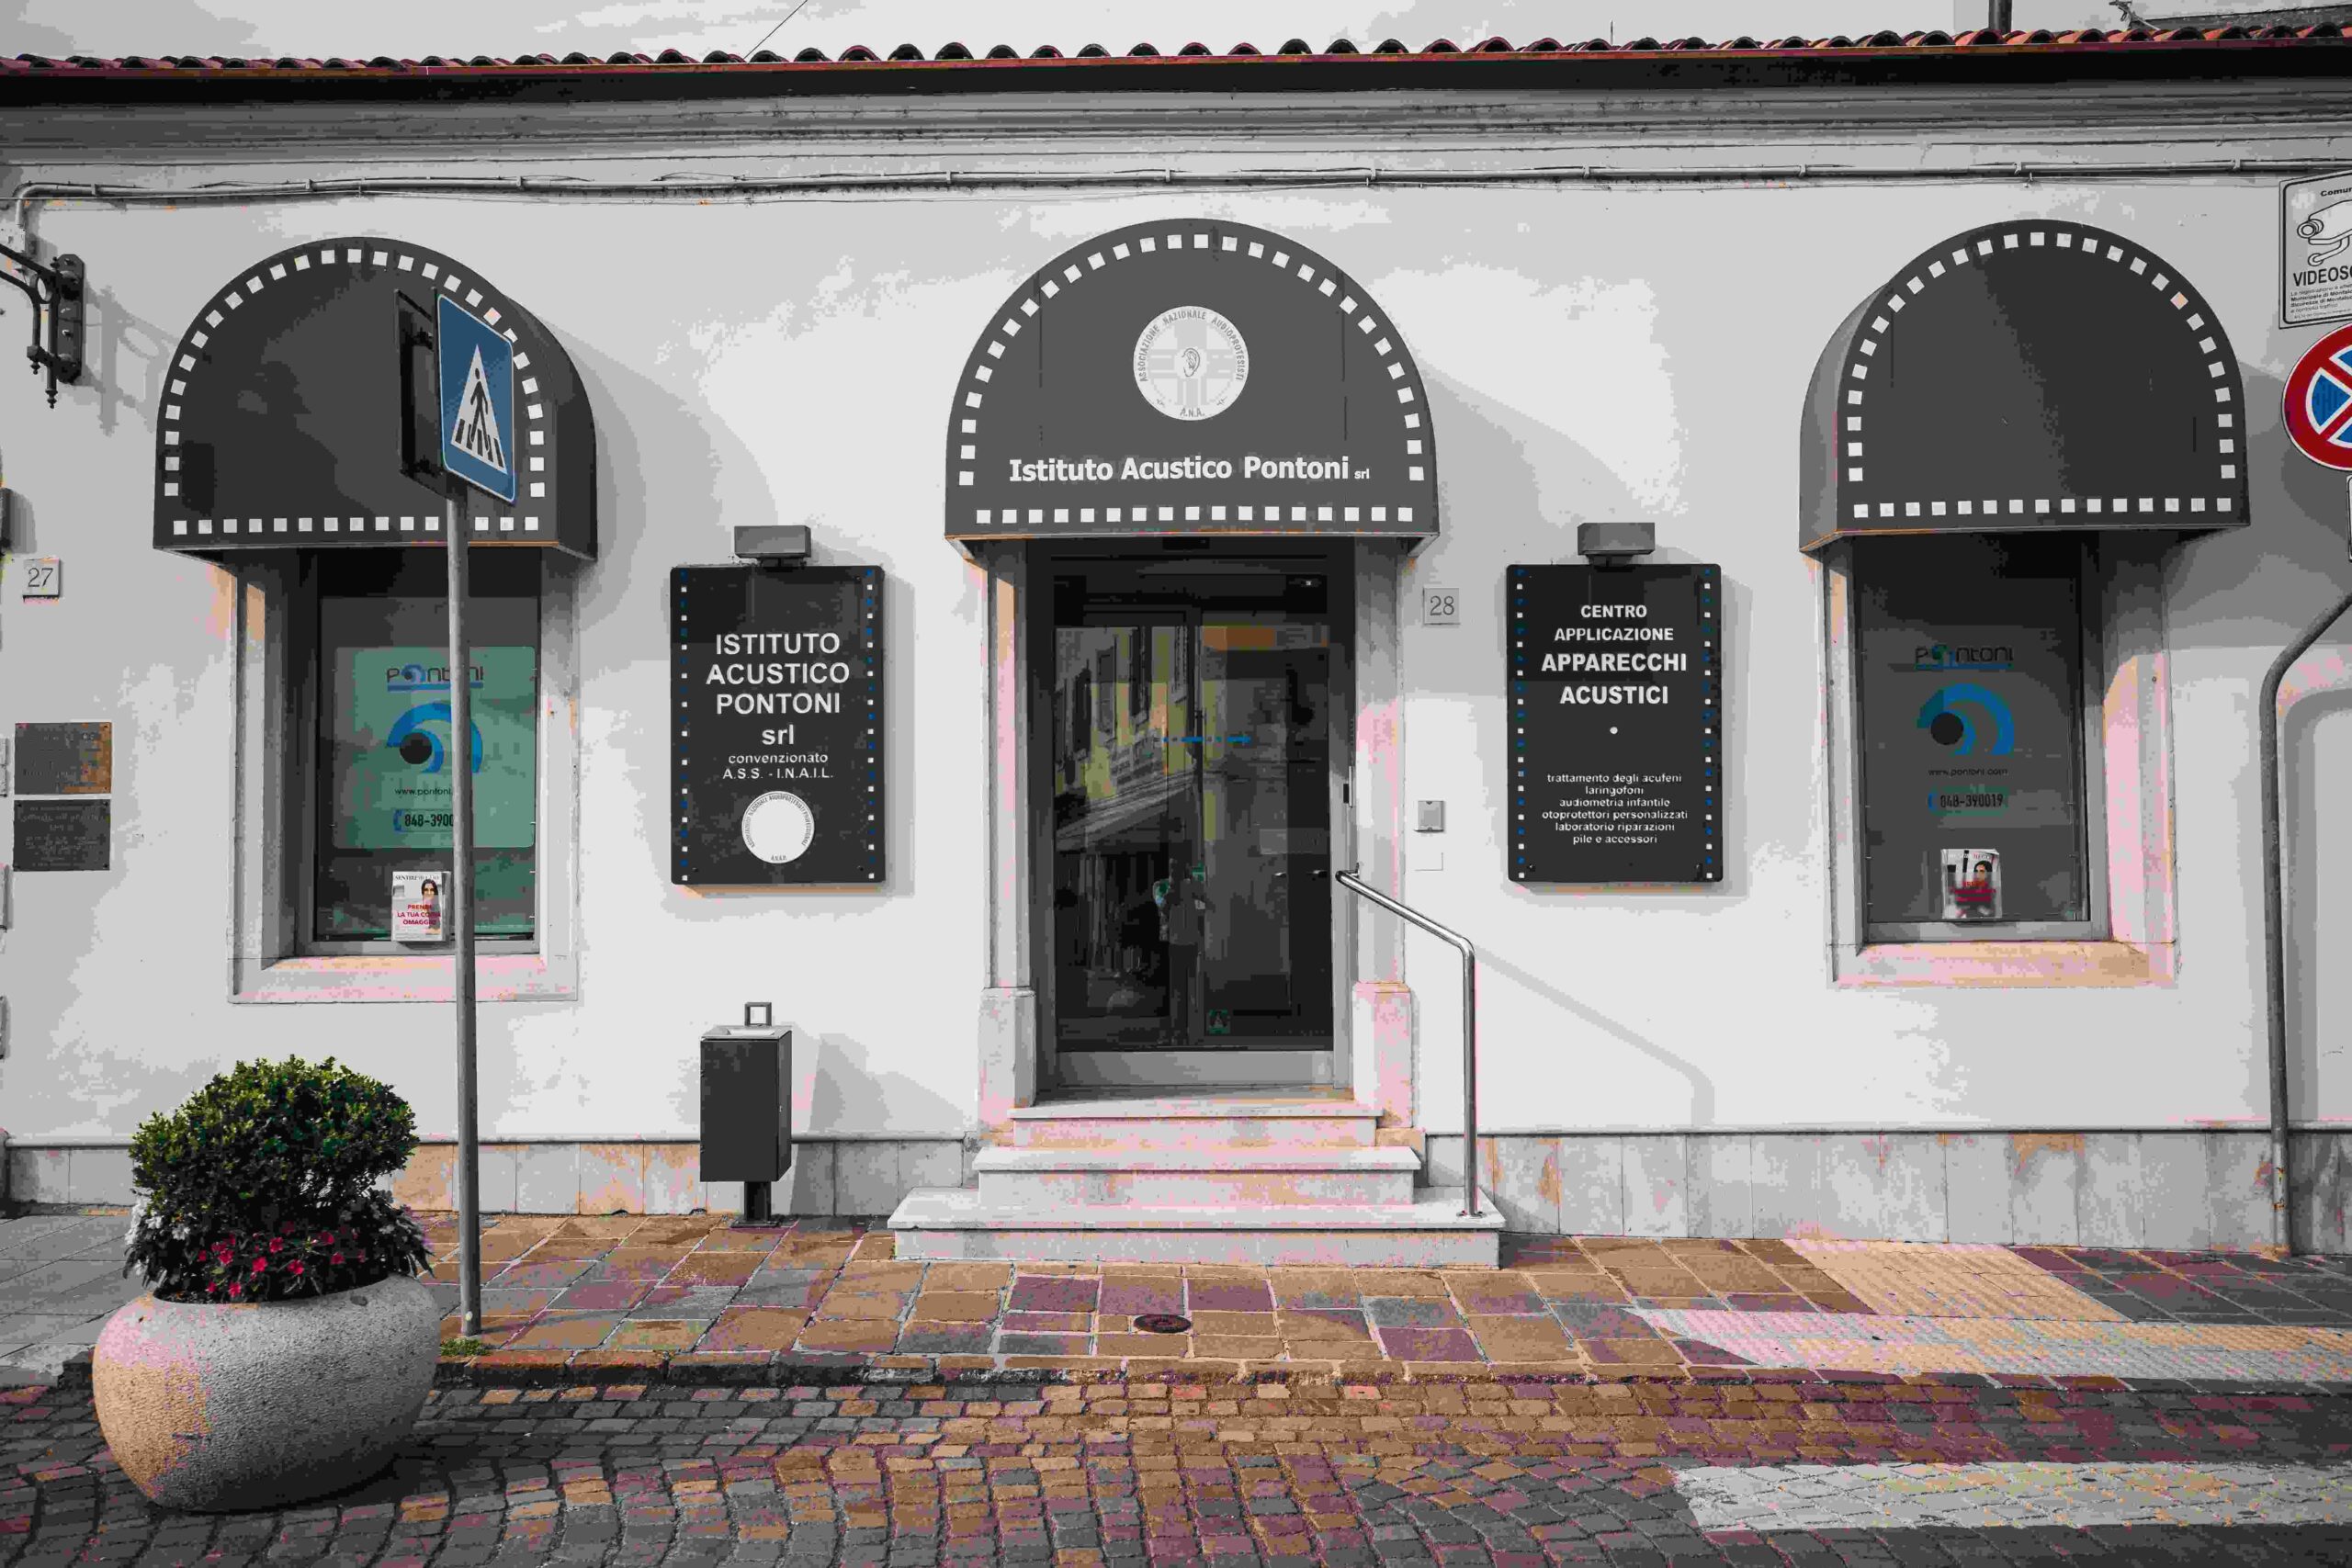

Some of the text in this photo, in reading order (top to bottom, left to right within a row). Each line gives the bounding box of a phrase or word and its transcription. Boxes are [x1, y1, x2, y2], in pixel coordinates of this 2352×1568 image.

[2293, 265, 2352, 287] VIDEOS
[1137, 310, 1245, 382] ASSOCIAZIONE NAZIONALE AUDIOPROTESISTI
[1010, 455, 1370, 482] Istituto Acustico Pontoni srl
[28, 567, 53, 588] 27
[1430, 595, 1454, 615] 28
[1580, 604, 1647, 618] CENTRO
[1554, 627, 1674, 641] APPLICAZIONE
[716, 633, 841, 655] ISTITUTO
[1541, 653, 1687, 671] APPARECCHI
[706, 662, 850, 684] ACUSTICO
[717, 693, 840, 715] PONTONI
[1559, 685, 1668, 705] ACUSTICI
[762, 725, 795, 745] srl
[728, 752, 829, 764] convenzionato
[1547, 773, 1682, 785] trattamento degli acufeni
[1585, 785, 1644, 797] laringofoni
[1559, 797, 1670, 807] audiometria infantile
[1542, 809, 1688, 821] otoprotettori personalizzati
[1555, 821, 1675, 833] laboratorio riparazioni
[1573, 834, 1592, 845] pile
[1605, 834, 1657, 844] accessori
